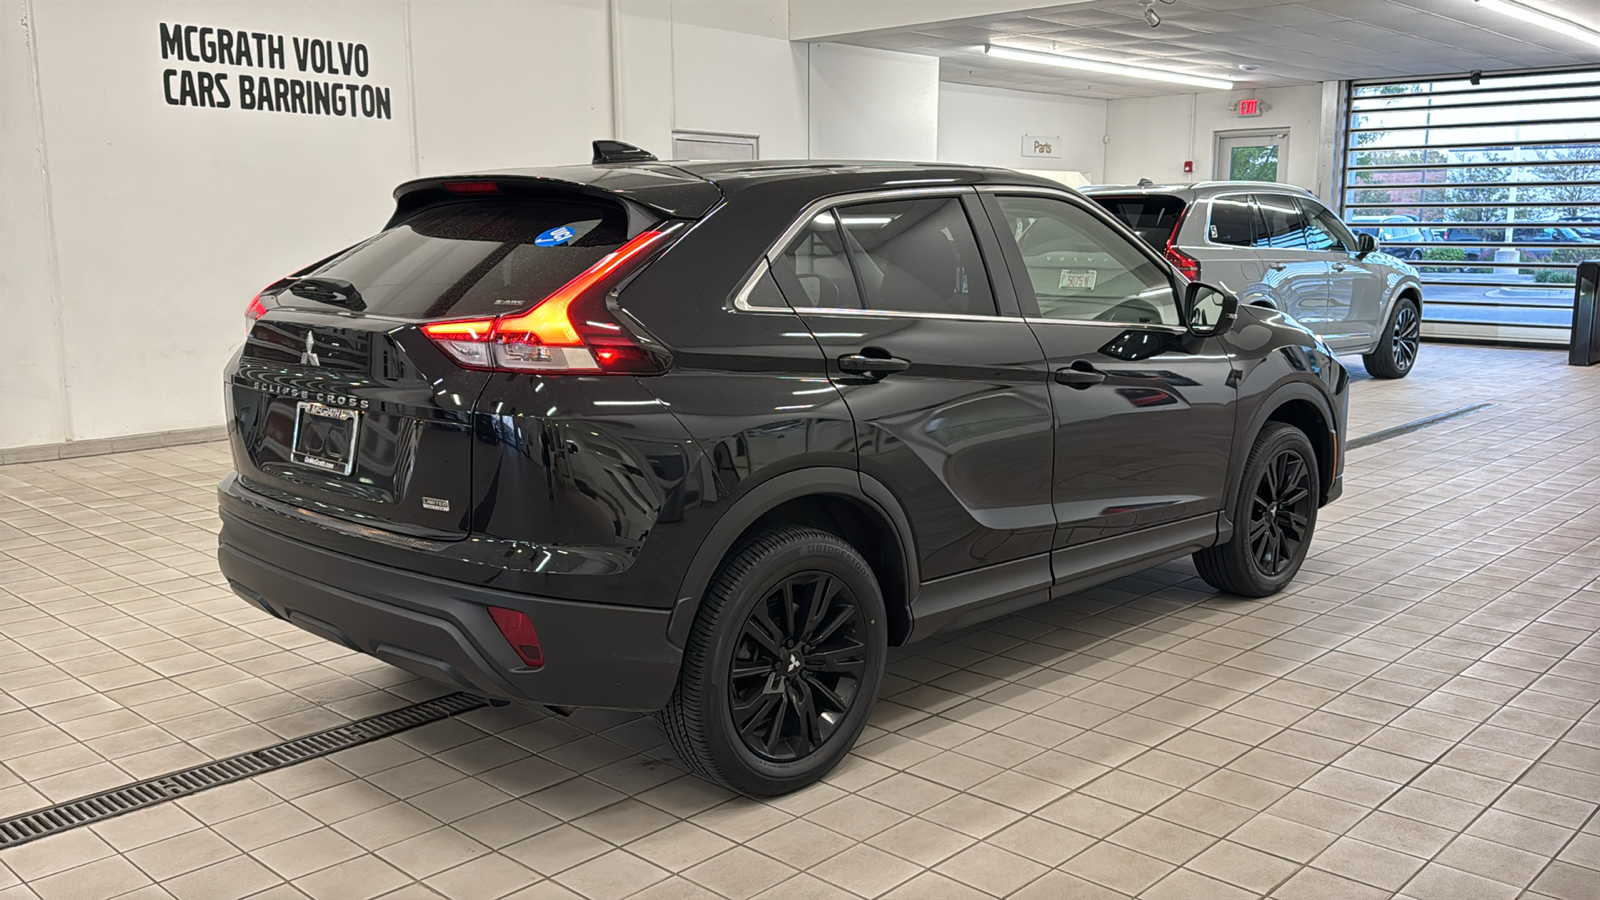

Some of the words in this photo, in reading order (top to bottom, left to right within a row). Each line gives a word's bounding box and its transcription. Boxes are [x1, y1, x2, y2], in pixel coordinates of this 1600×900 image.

[159, 22, 285, 70] MCGRATH
[292, 37, 369, 78] VOLVO
[163, 68, 231, 108] CARS
[239, 74, 391, 119] BARRINGTON
[1239, 99, 1258, 115] EXIT
[1033, 140, 1052, 154] Parts
[550, 226, 573, 242] UCI
[253, 382, 309, 399] ECLIPSE
[316, 392, 369, 409] CROSS
[423, 498, 447, 508] LIMITED
